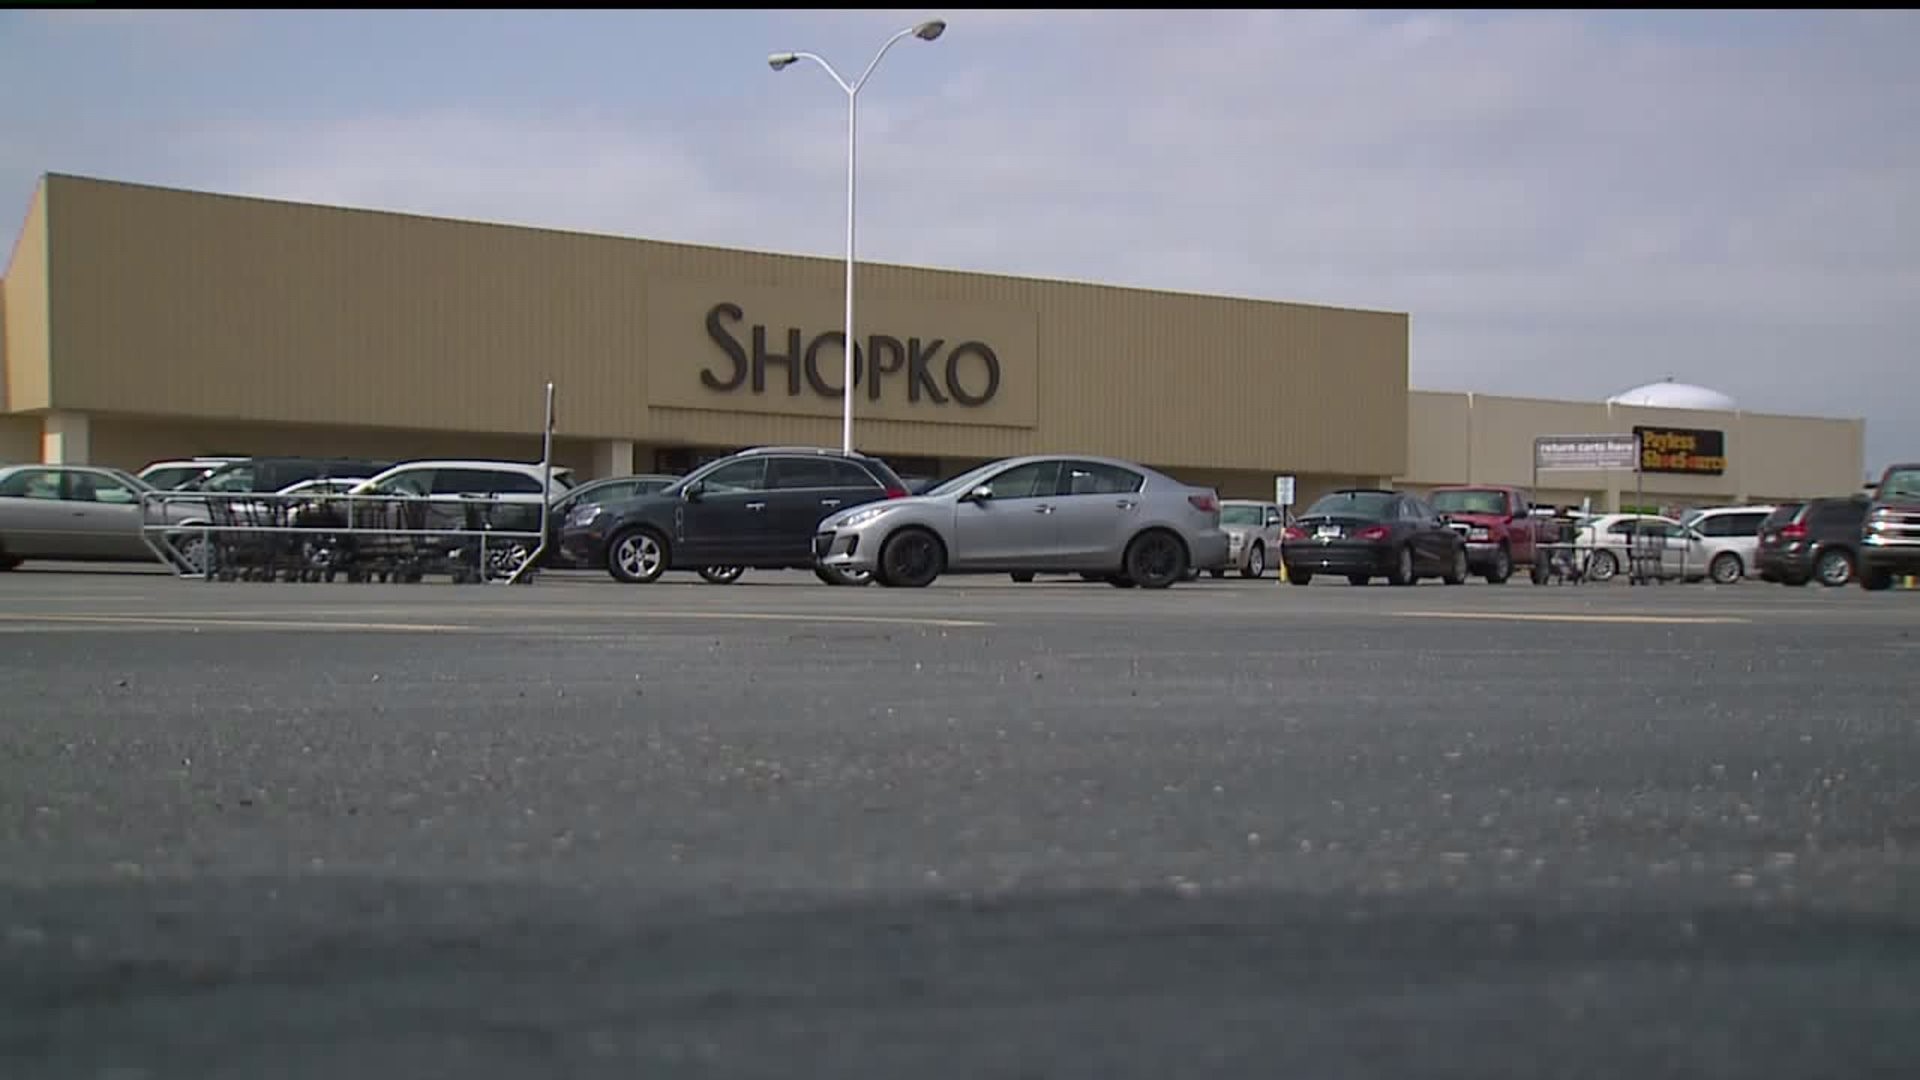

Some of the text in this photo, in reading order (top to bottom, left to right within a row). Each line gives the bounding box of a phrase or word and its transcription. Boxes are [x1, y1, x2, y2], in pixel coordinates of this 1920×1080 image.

[701, 302, 1000, 407] SHOPKO
[1540, 440, 1633, 451] return carts here
[1643, 430, 1696, 450] Payless
